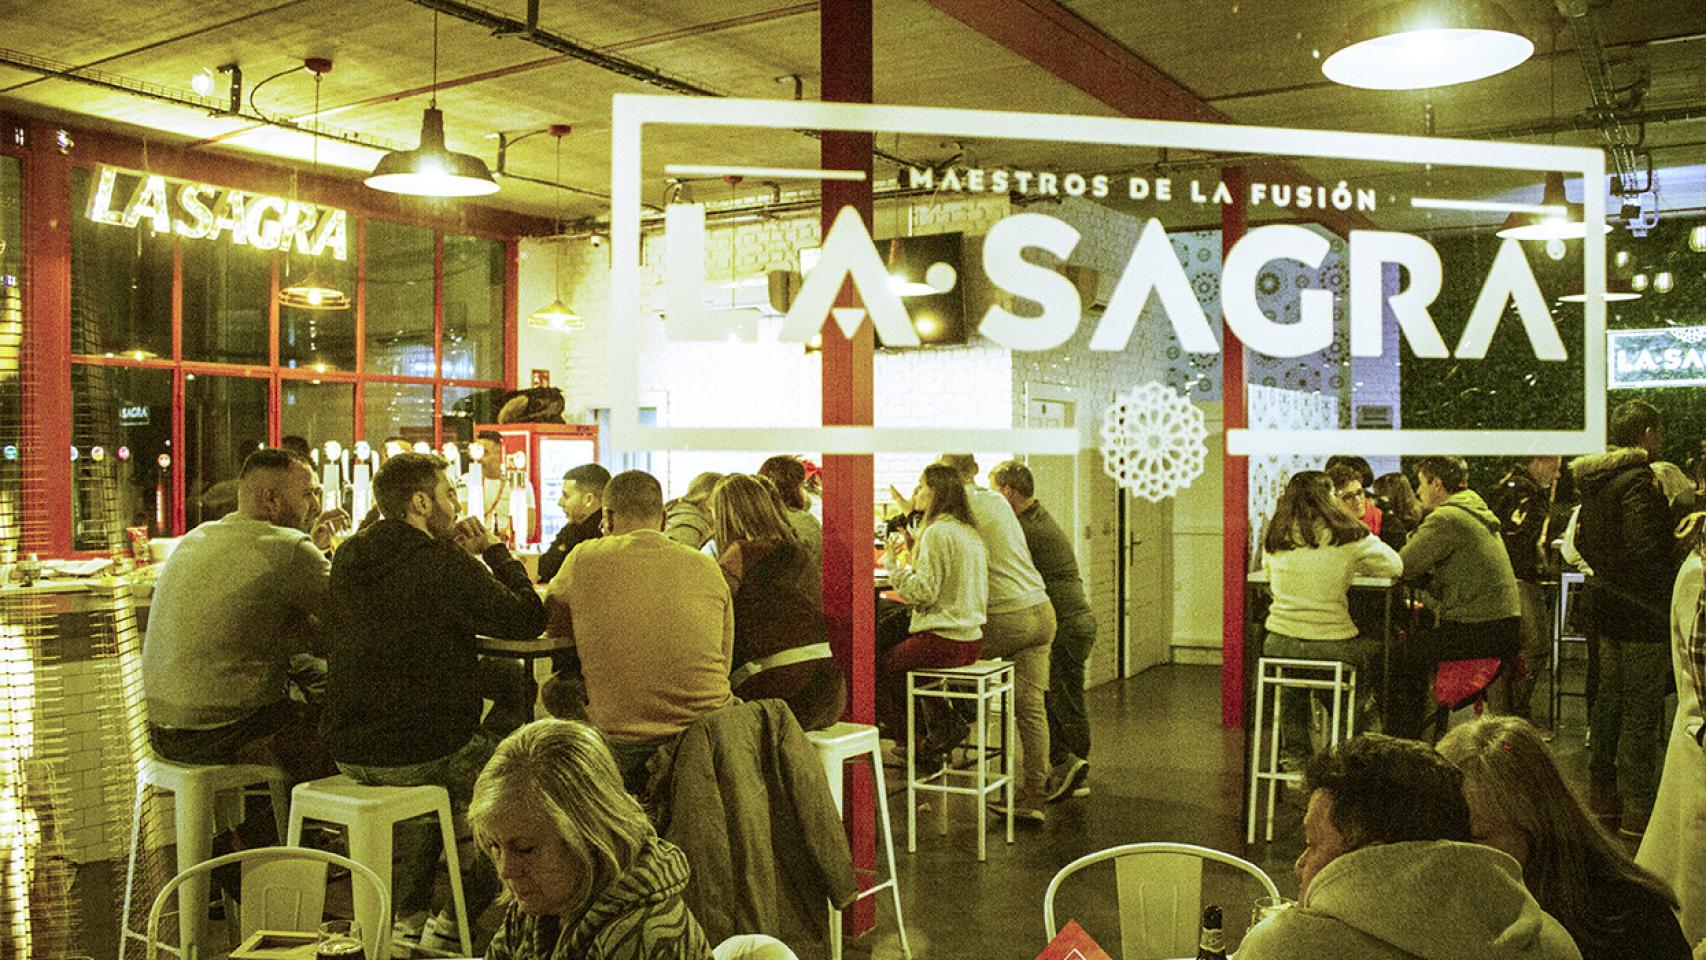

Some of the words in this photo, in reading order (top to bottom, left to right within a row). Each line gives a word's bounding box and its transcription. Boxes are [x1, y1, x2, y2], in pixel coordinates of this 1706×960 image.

[88, 165, 171, 234] LA
[172, 182, 348, 261] SAGRA
[908, 166, 1109, 198] MAESTROS
[1128, 176, 1172, 201] DE
[1189, 179, 1234, 205] LA
[1250, 179, 1378, 212] FUSIÓN
[977, 212, 1569, 361] SAGRA
[1662, 346, 1706, 371] SA
